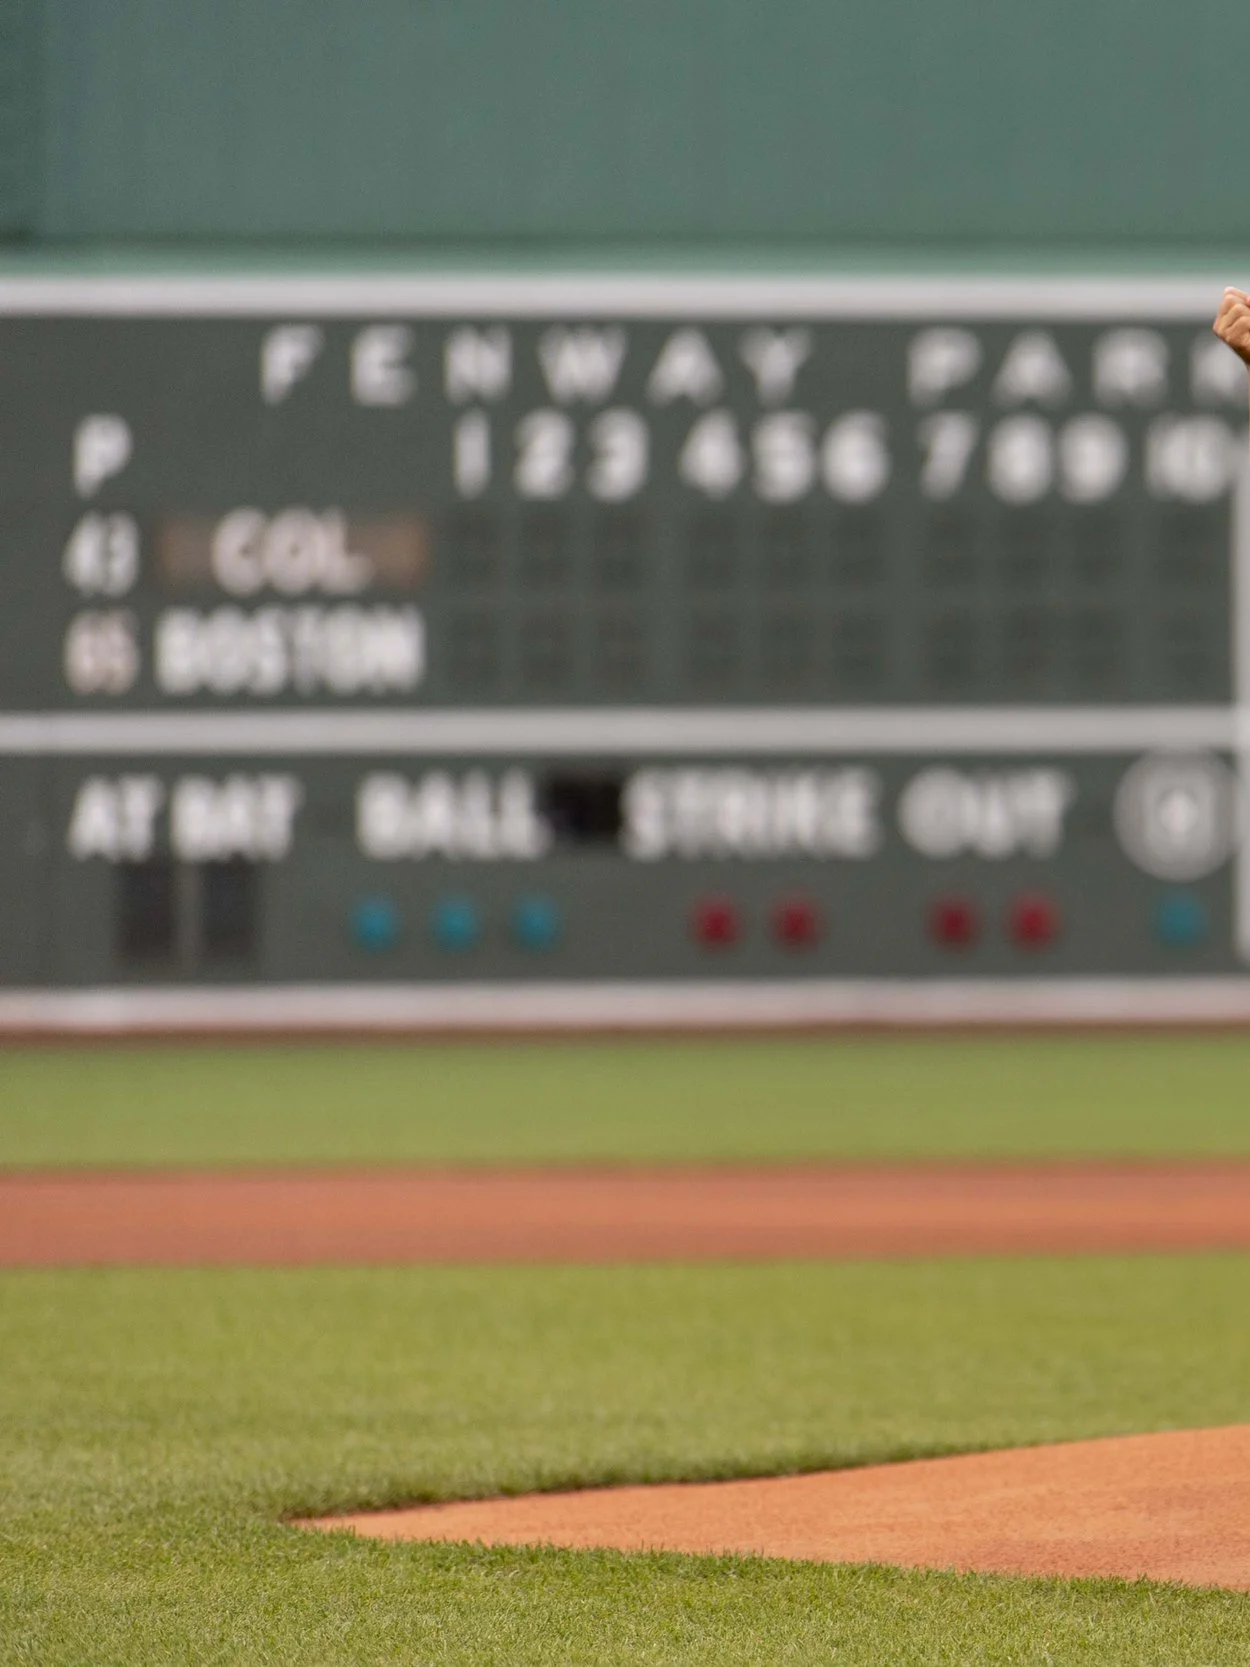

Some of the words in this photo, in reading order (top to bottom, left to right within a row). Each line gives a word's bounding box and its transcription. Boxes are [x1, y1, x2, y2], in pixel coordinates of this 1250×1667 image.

[261, 325, 812, 405] FENWAY
[74, 414, 131, 496] P
[453, 410, 491, 498] 1
[515, 410, 574, 498] 2
[589, 410, 648, 498] 3
[680, 411, 742, 498] 4
[753, 411, 816, 500] 5
[822, 411, 888, 500] 6
[921, 411, 977, 497] 7
[209, 507, 376, 596] COL
[154, 605, 426, 695] BOSTON
[68, 773, 163, 860] AT
[168, 773, 302, 860] BAT
[354, 767, 551, 860] BALL
[622, 764, 882, 860] STRIKE
[900, 765, 1072, 860] OUT
